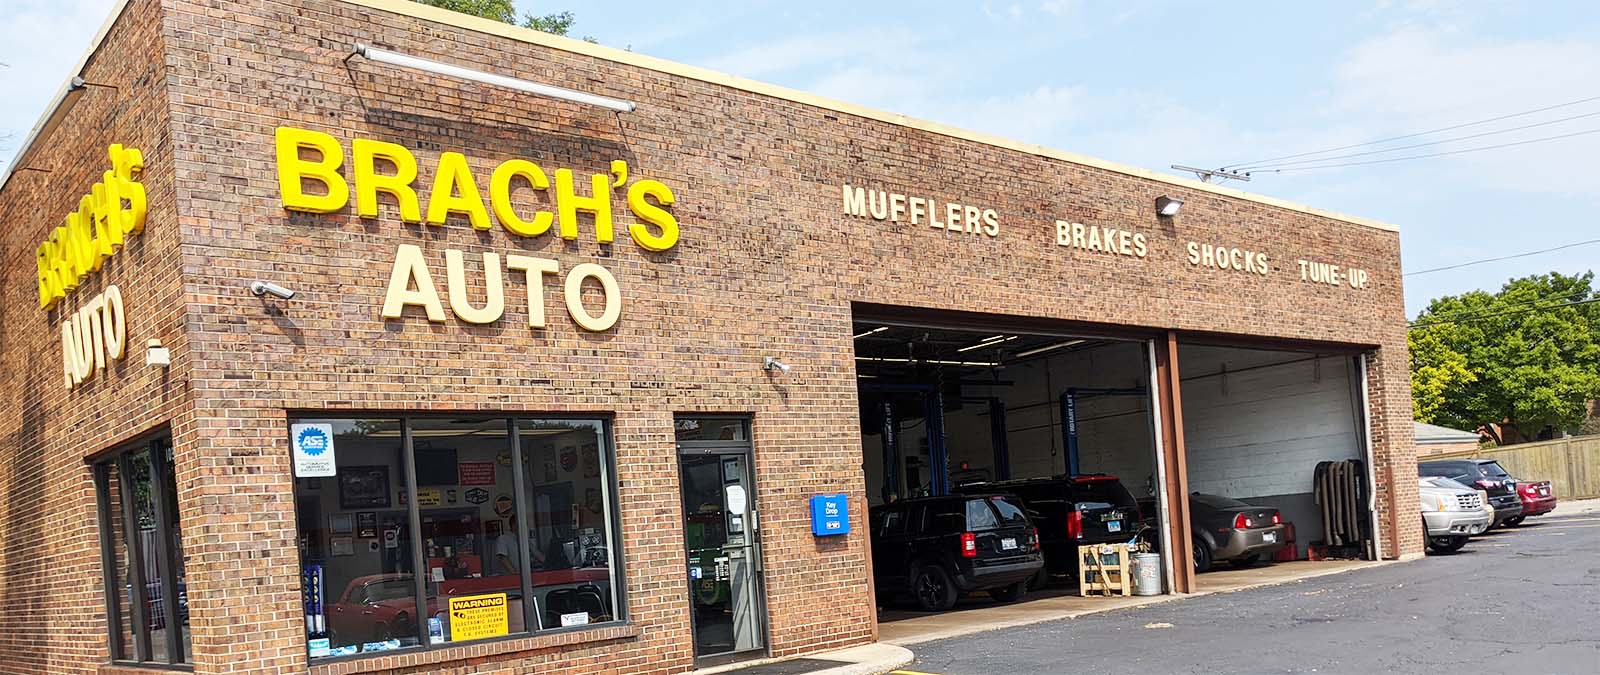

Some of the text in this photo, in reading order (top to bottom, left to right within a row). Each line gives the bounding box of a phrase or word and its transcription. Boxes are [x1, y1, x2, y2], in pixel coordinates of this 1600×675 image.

[275, 126, 680, 251] BRACH'S
[842, 185, 1369, 290] MUFFLERS BRAKES SHOCKS TUNE-UP
[381, 243, 622, 332] AUTO
[61, 284, 126, 391] AUTO
[301, 436, 323, 446] ASE
[453, 598, 503, 609] WARNING
